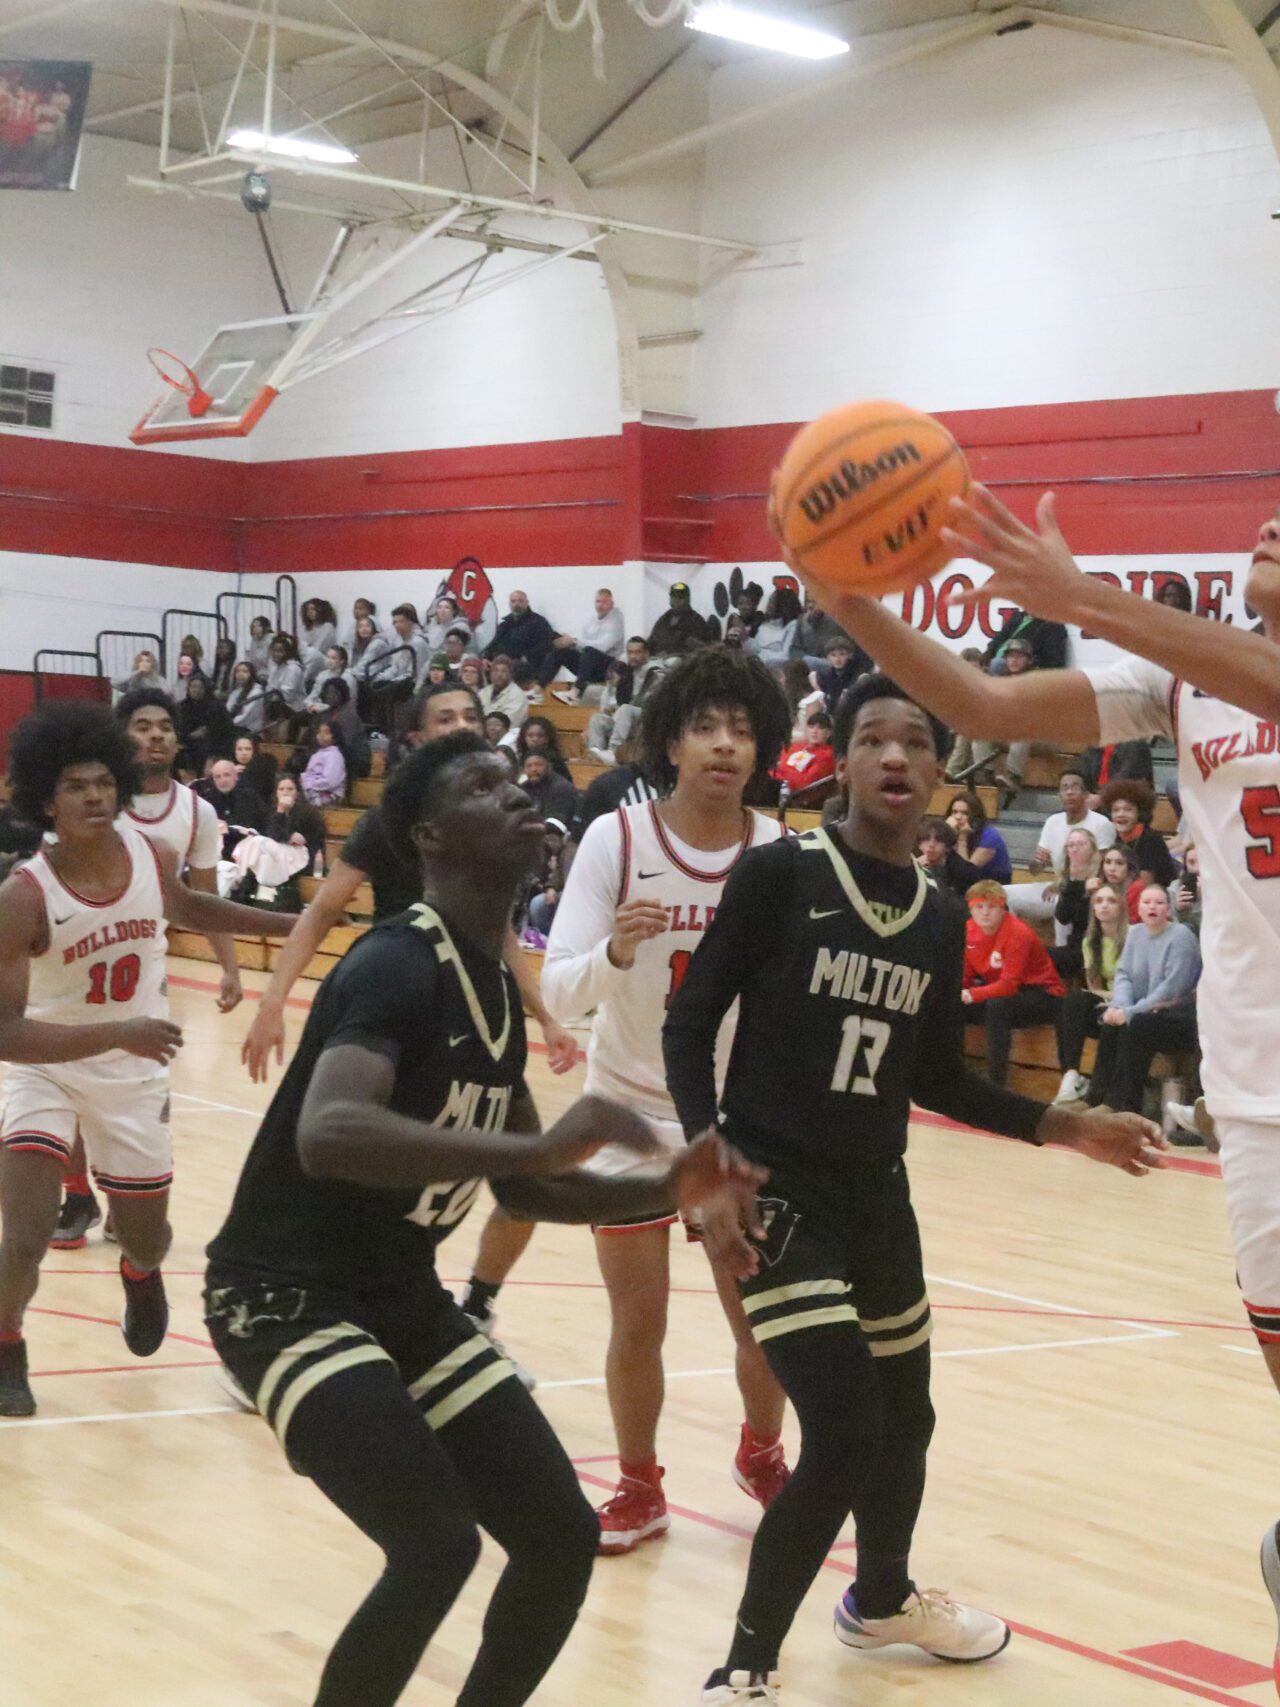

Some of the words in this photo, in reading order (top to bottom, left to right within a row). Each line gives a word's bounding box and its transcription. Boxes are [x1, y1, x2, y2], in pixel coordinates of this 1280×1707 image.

[800, 441, 922, 524] Wilson
[461, 570, 477, 601] C
[62, 918, 157, 966] BULLDOGS
[85, 953, 141, 1004] 10
[809, 947, 931, 1016] MILTON
